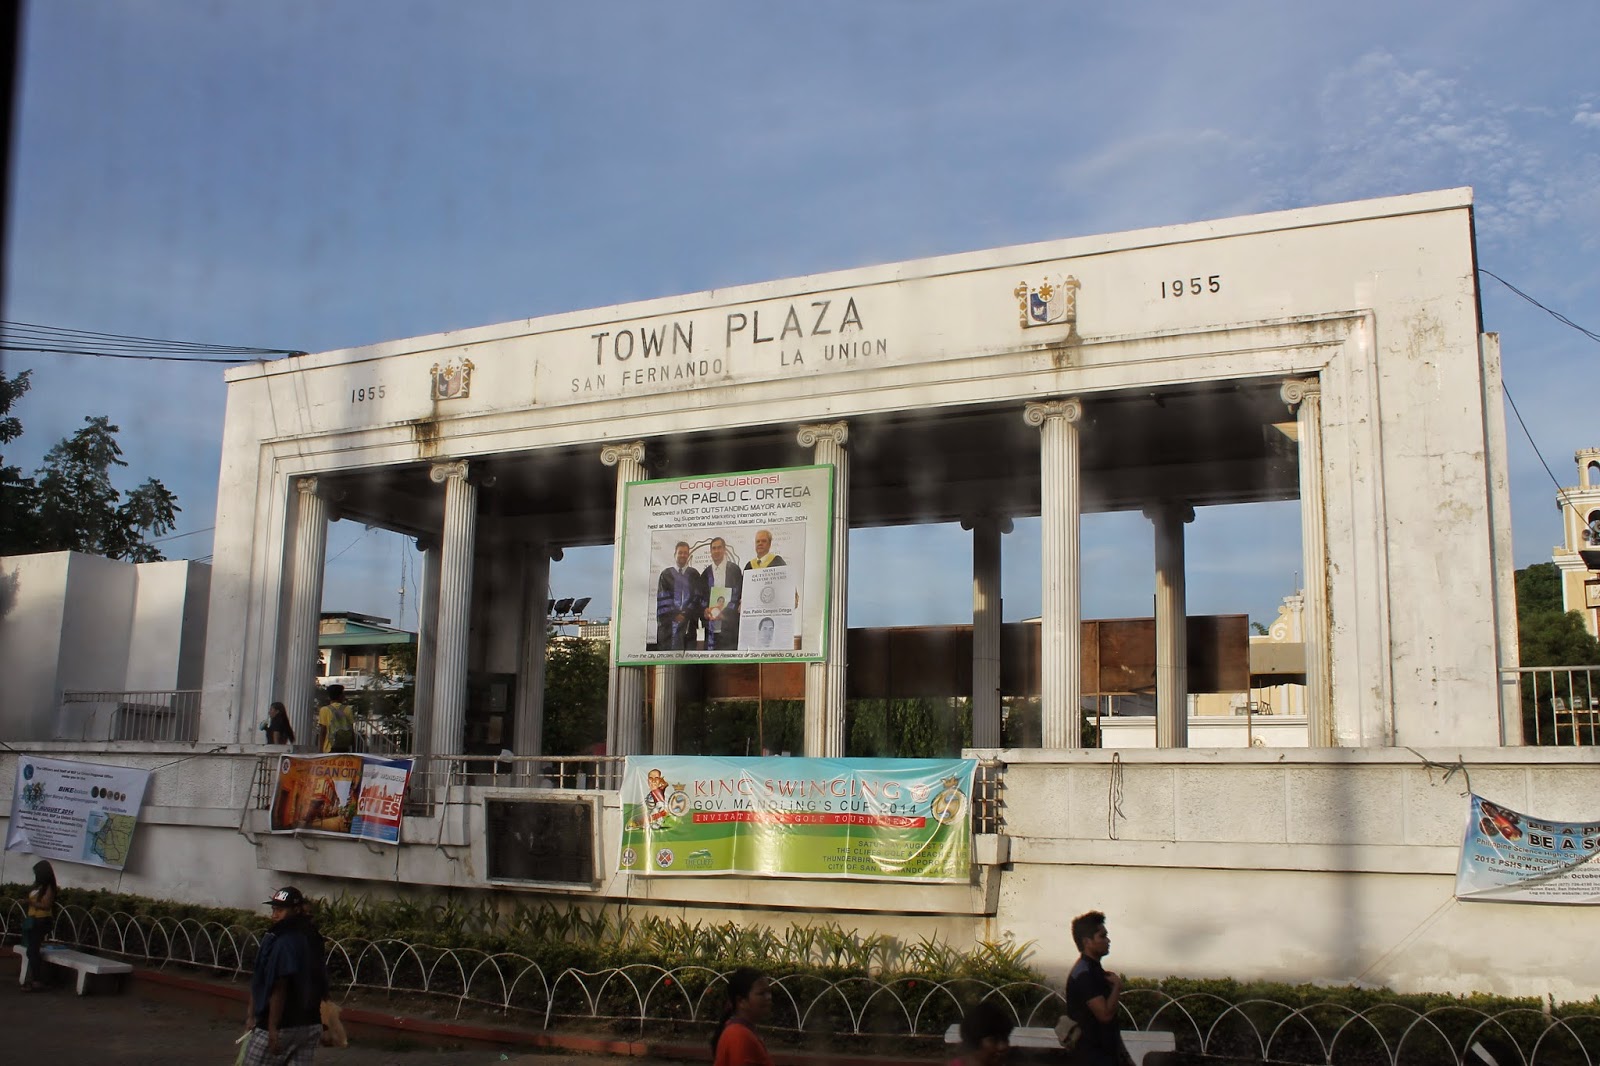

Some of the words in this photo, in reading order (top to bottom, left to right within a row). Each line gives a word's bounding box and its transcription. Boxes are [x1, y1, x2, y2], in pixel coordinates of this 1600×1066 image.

[1161, 275, 1221, 299] 1955
[591, 320, 693, 366] TOWN
[726, 296, 864, 348] PLAZA
[571, 374, 606, 393] SAN
[622, 358, 723, 387] FERNANDO
[781, 349, 804, 367] LA
[824, 338, 887, 361] UNION
[352, 386, 386, 403] 1955
[679, 474, 780, 490] Congratulations!
[643, 494, 689, 507] MAYOR
[692, 490, 736, 504] PABLO
[740, 490, 752, 501] C.
[756, 486, 811, 501] ORTEGA
[681, 507, 700, 515] MOST
[701, 504, 749, 514] OUTSTANDING
[750, 503, 775, 511] MAYOR
[777, 501, 801, 509] AWARD
[694, 777, 753, 798] KING
[764, 778, 901, 799] SWINGING
[359, 797, 399, 816] CITIES
[693, 800, 726, 811] GOV.
[839, 801, 870, 812] CUP
[879, 803, 917, 815] 2014
[1529, 833, 1554, 850] BE
[1561, 838, 1577, 850] A
[860, 864, 877, 872] SAN
[1475, 855, 1496, 865] 2015
[1498, 859, 1524, 869] PSHS
